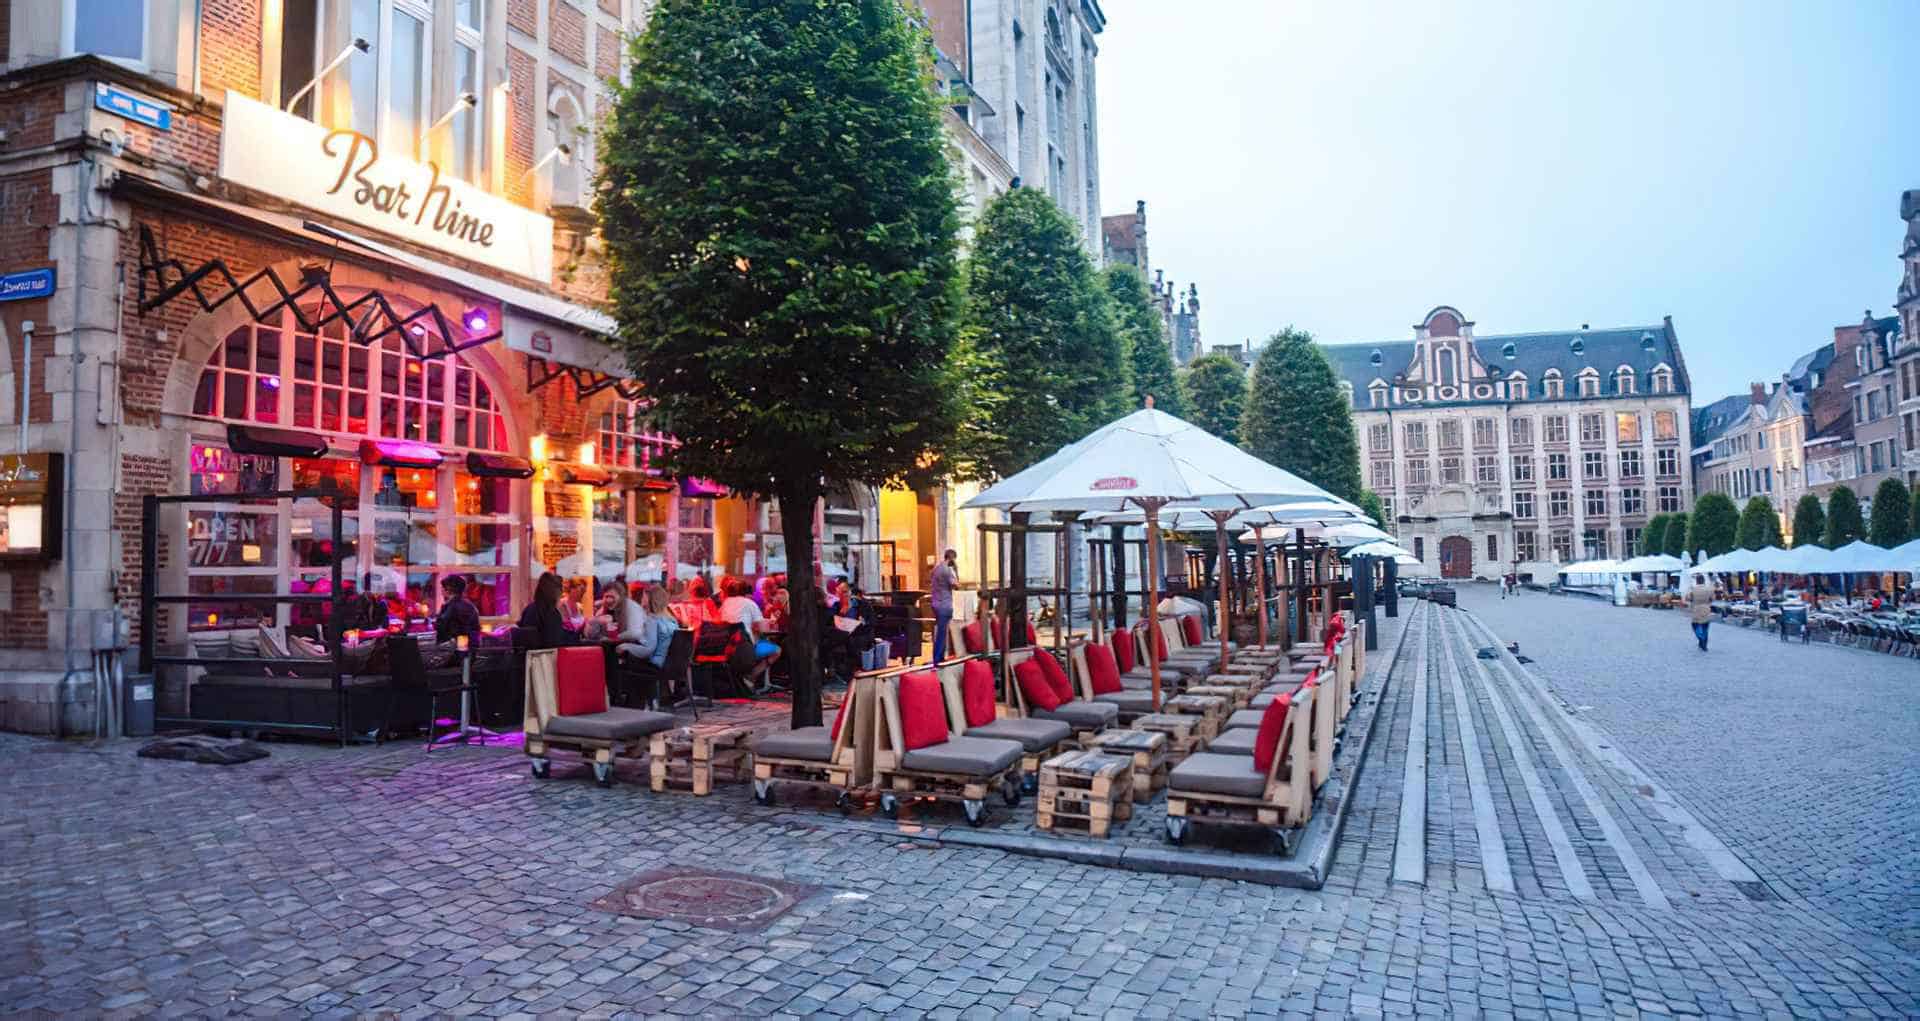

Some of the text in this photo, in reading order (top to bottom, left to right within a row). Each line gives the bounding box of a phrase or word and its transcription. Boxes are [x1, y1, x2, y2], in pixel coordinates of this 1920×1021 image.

[322, 129, 493, 246] Bar Nine
[192, 517, 255, 542] OPEN
